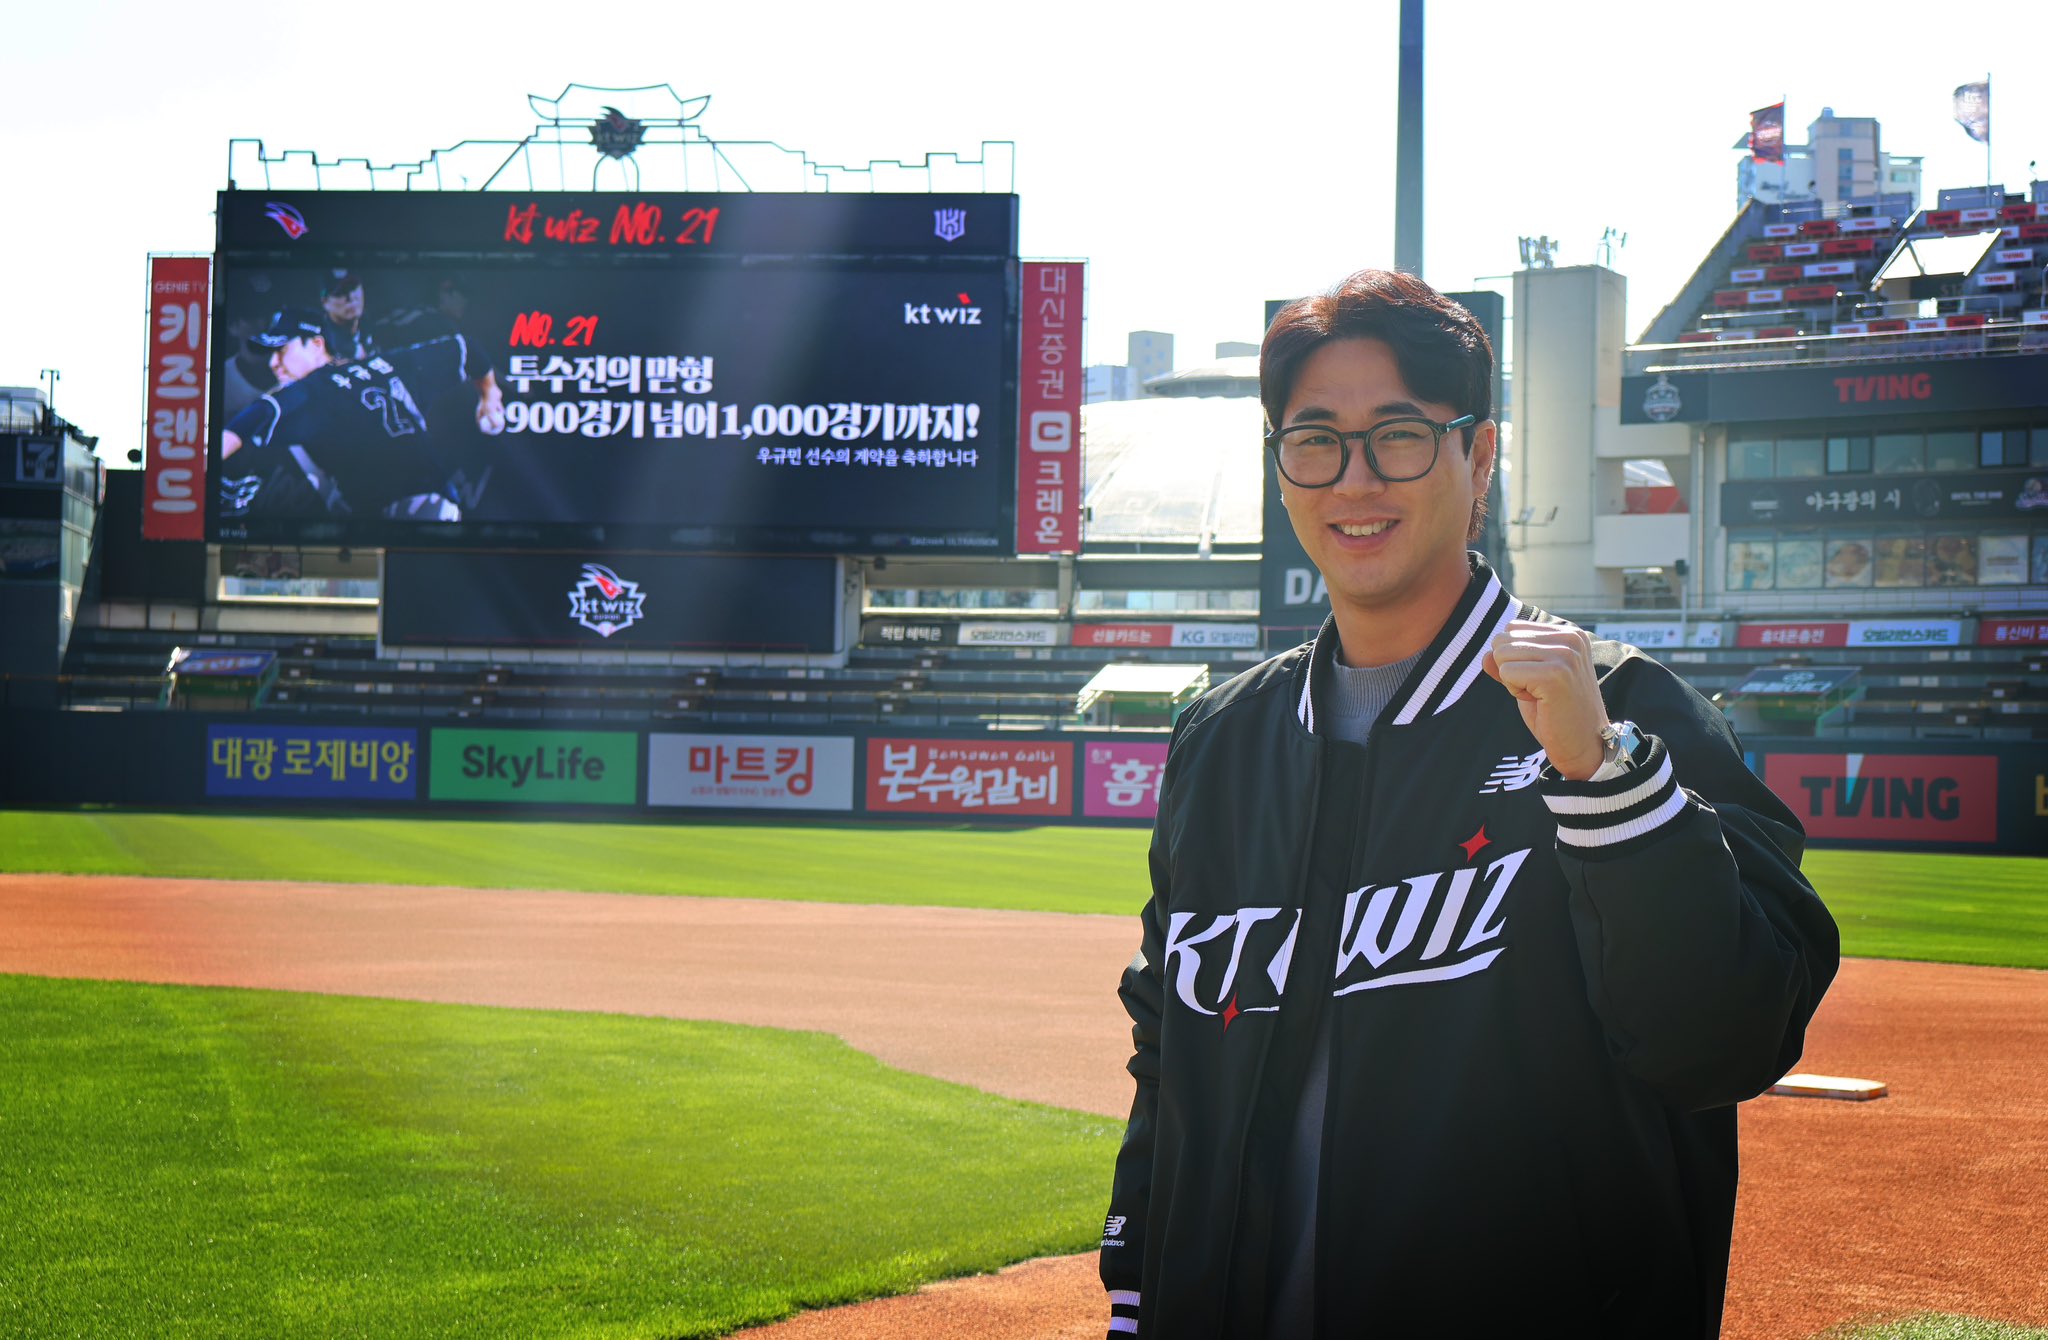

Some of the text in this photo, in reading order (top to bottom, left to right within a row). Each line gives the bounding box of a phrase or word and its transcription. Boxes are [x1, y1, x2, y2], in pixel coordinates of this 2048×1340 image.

[504, 203, 541, 244] kt
[544, 210, 600, 244] wiz
[676, 207, 720, 244] 21
[509, 310, 599, 348] NO. 21
[904, 293, 982, 325] kt wiz
[1037, 267, 1067, 400] 대신증권
[505, 354, 714, 395] 투수진의 맏형
[1834, 372, 1932, 403] TVING
[151, 301, 201, 514] 키즈랜드
[505, 400, 980, 441] 900경기 넘어 1,000경기까지!
[757, 447, 979, 467] 우규민 선수의 계약을 축하합니다
[1035, 460, 1064, 544] 크레온
[580, 598, 635, 614] kt wiz
[1181, 631, 1205, 644] KG
[211, 736, 415, 784] 대광 로제비앙
[461, 743, 606, 787] SkyLife
[689, 744, 814, 796] 마트킹
[879, 744, 1058, 808] 본수원갈비
[1103, 758, 1166, 807] 홈
[1801, 766, 1960, 821] TVING
